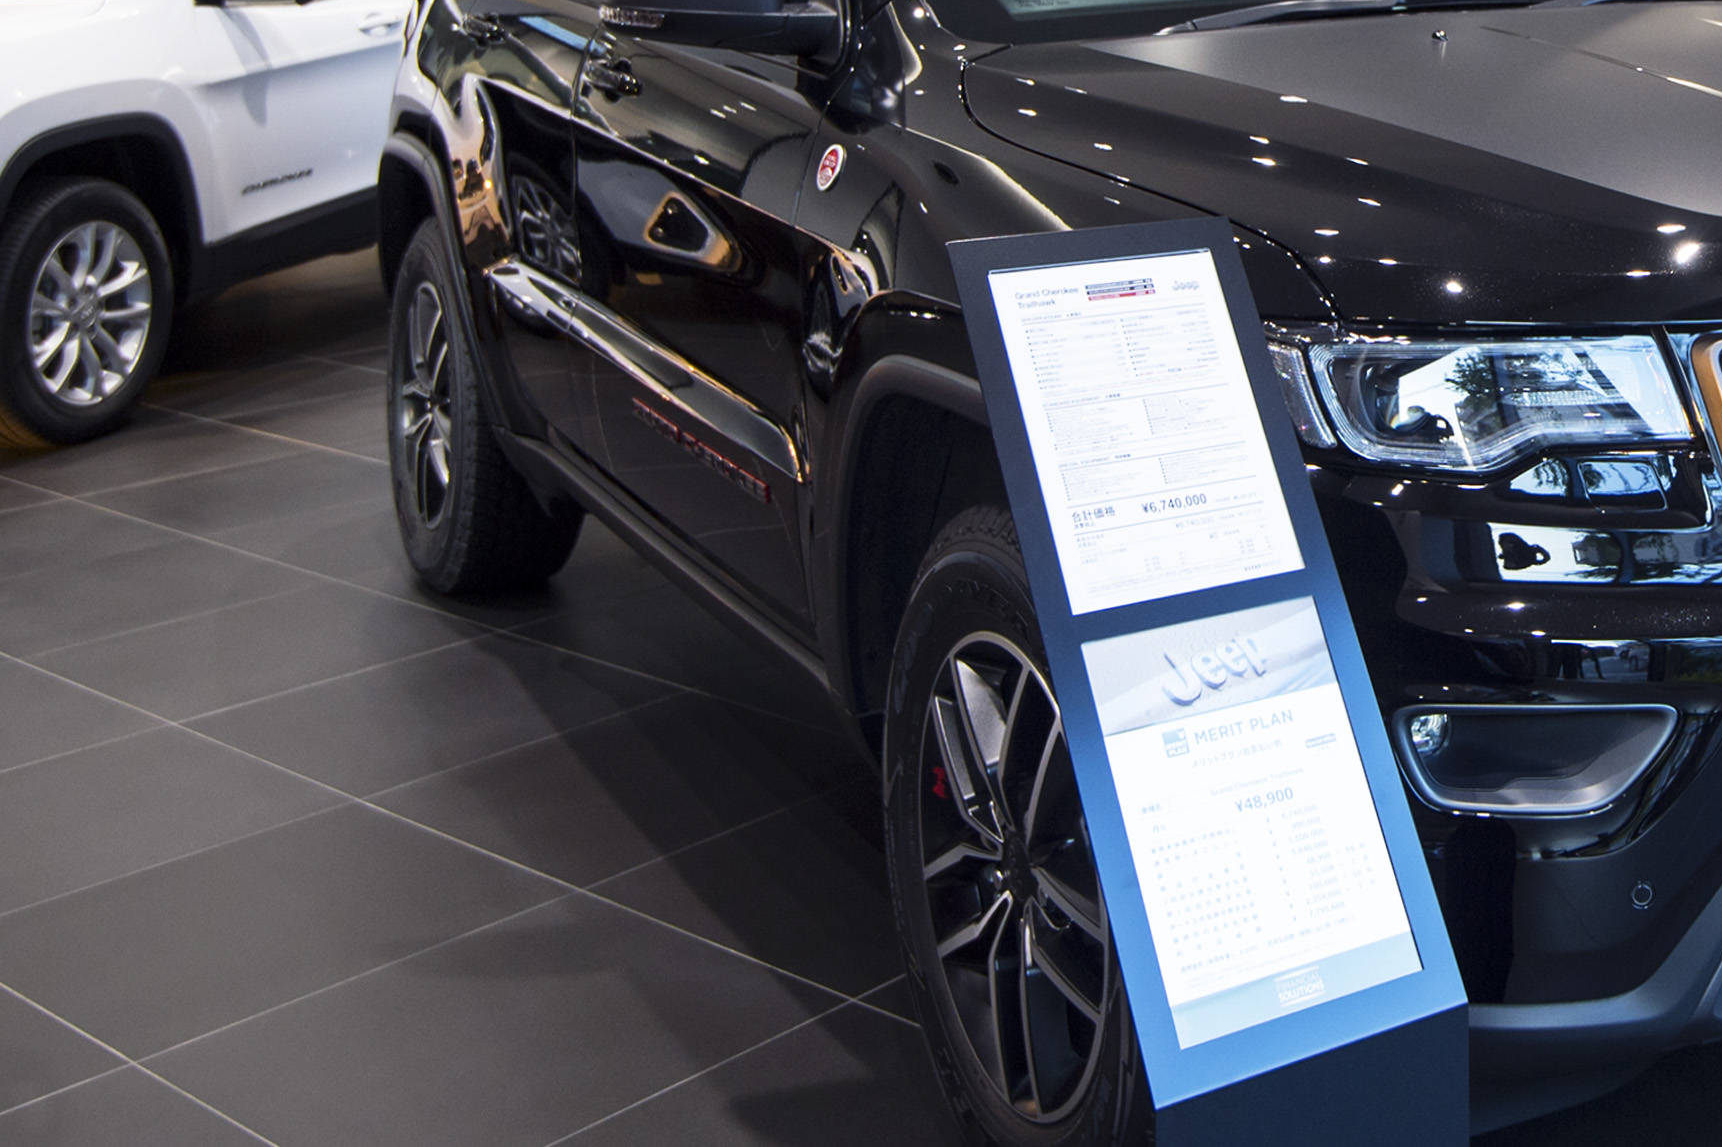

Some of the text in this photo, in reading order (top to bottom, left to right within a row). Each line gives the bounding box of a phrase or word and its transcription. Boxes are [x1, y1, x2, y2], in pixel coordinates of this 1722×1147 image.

[1071, 505, 1116, 522] 合計価格
[1142, 493, 1206, 513] ¥6,740,000
[1194, 710, 1293, 744] MERIT PLAN
[1235, 787, 1294, 813] ¥48,900
[1275, 971, 1320, 992] FINANCIAL
[1278, 980, 1323, 1002] SOLUTIONS
